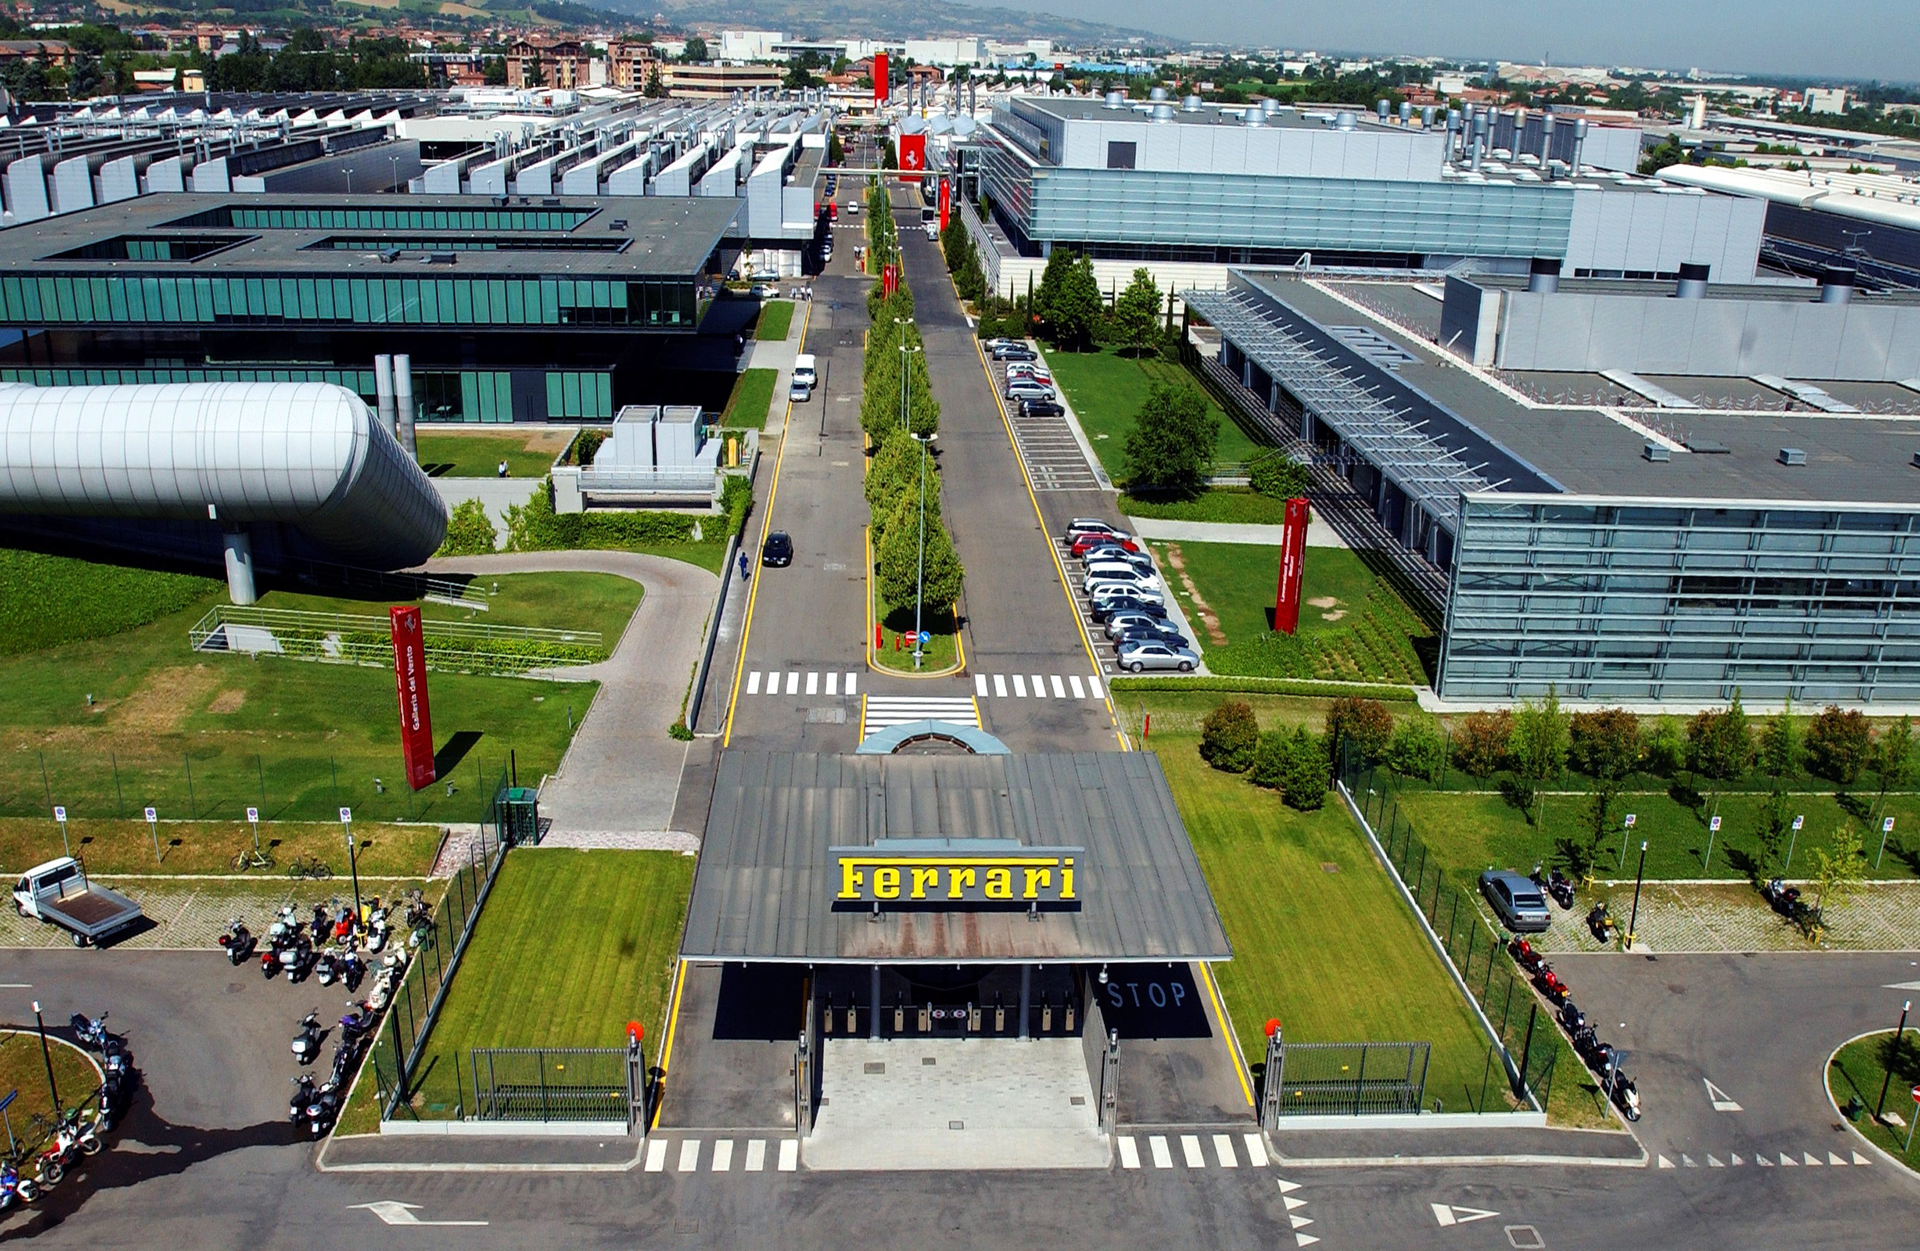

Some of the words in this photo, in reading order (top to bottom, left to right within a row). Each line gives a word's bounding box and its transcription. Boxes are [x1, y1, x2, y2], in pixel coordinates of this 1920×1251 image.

[411, 694, 420, 731] Galleria
[837, 857, 1076, 899] Ferrari
[1106, 982, 1185, 1008] STOP
